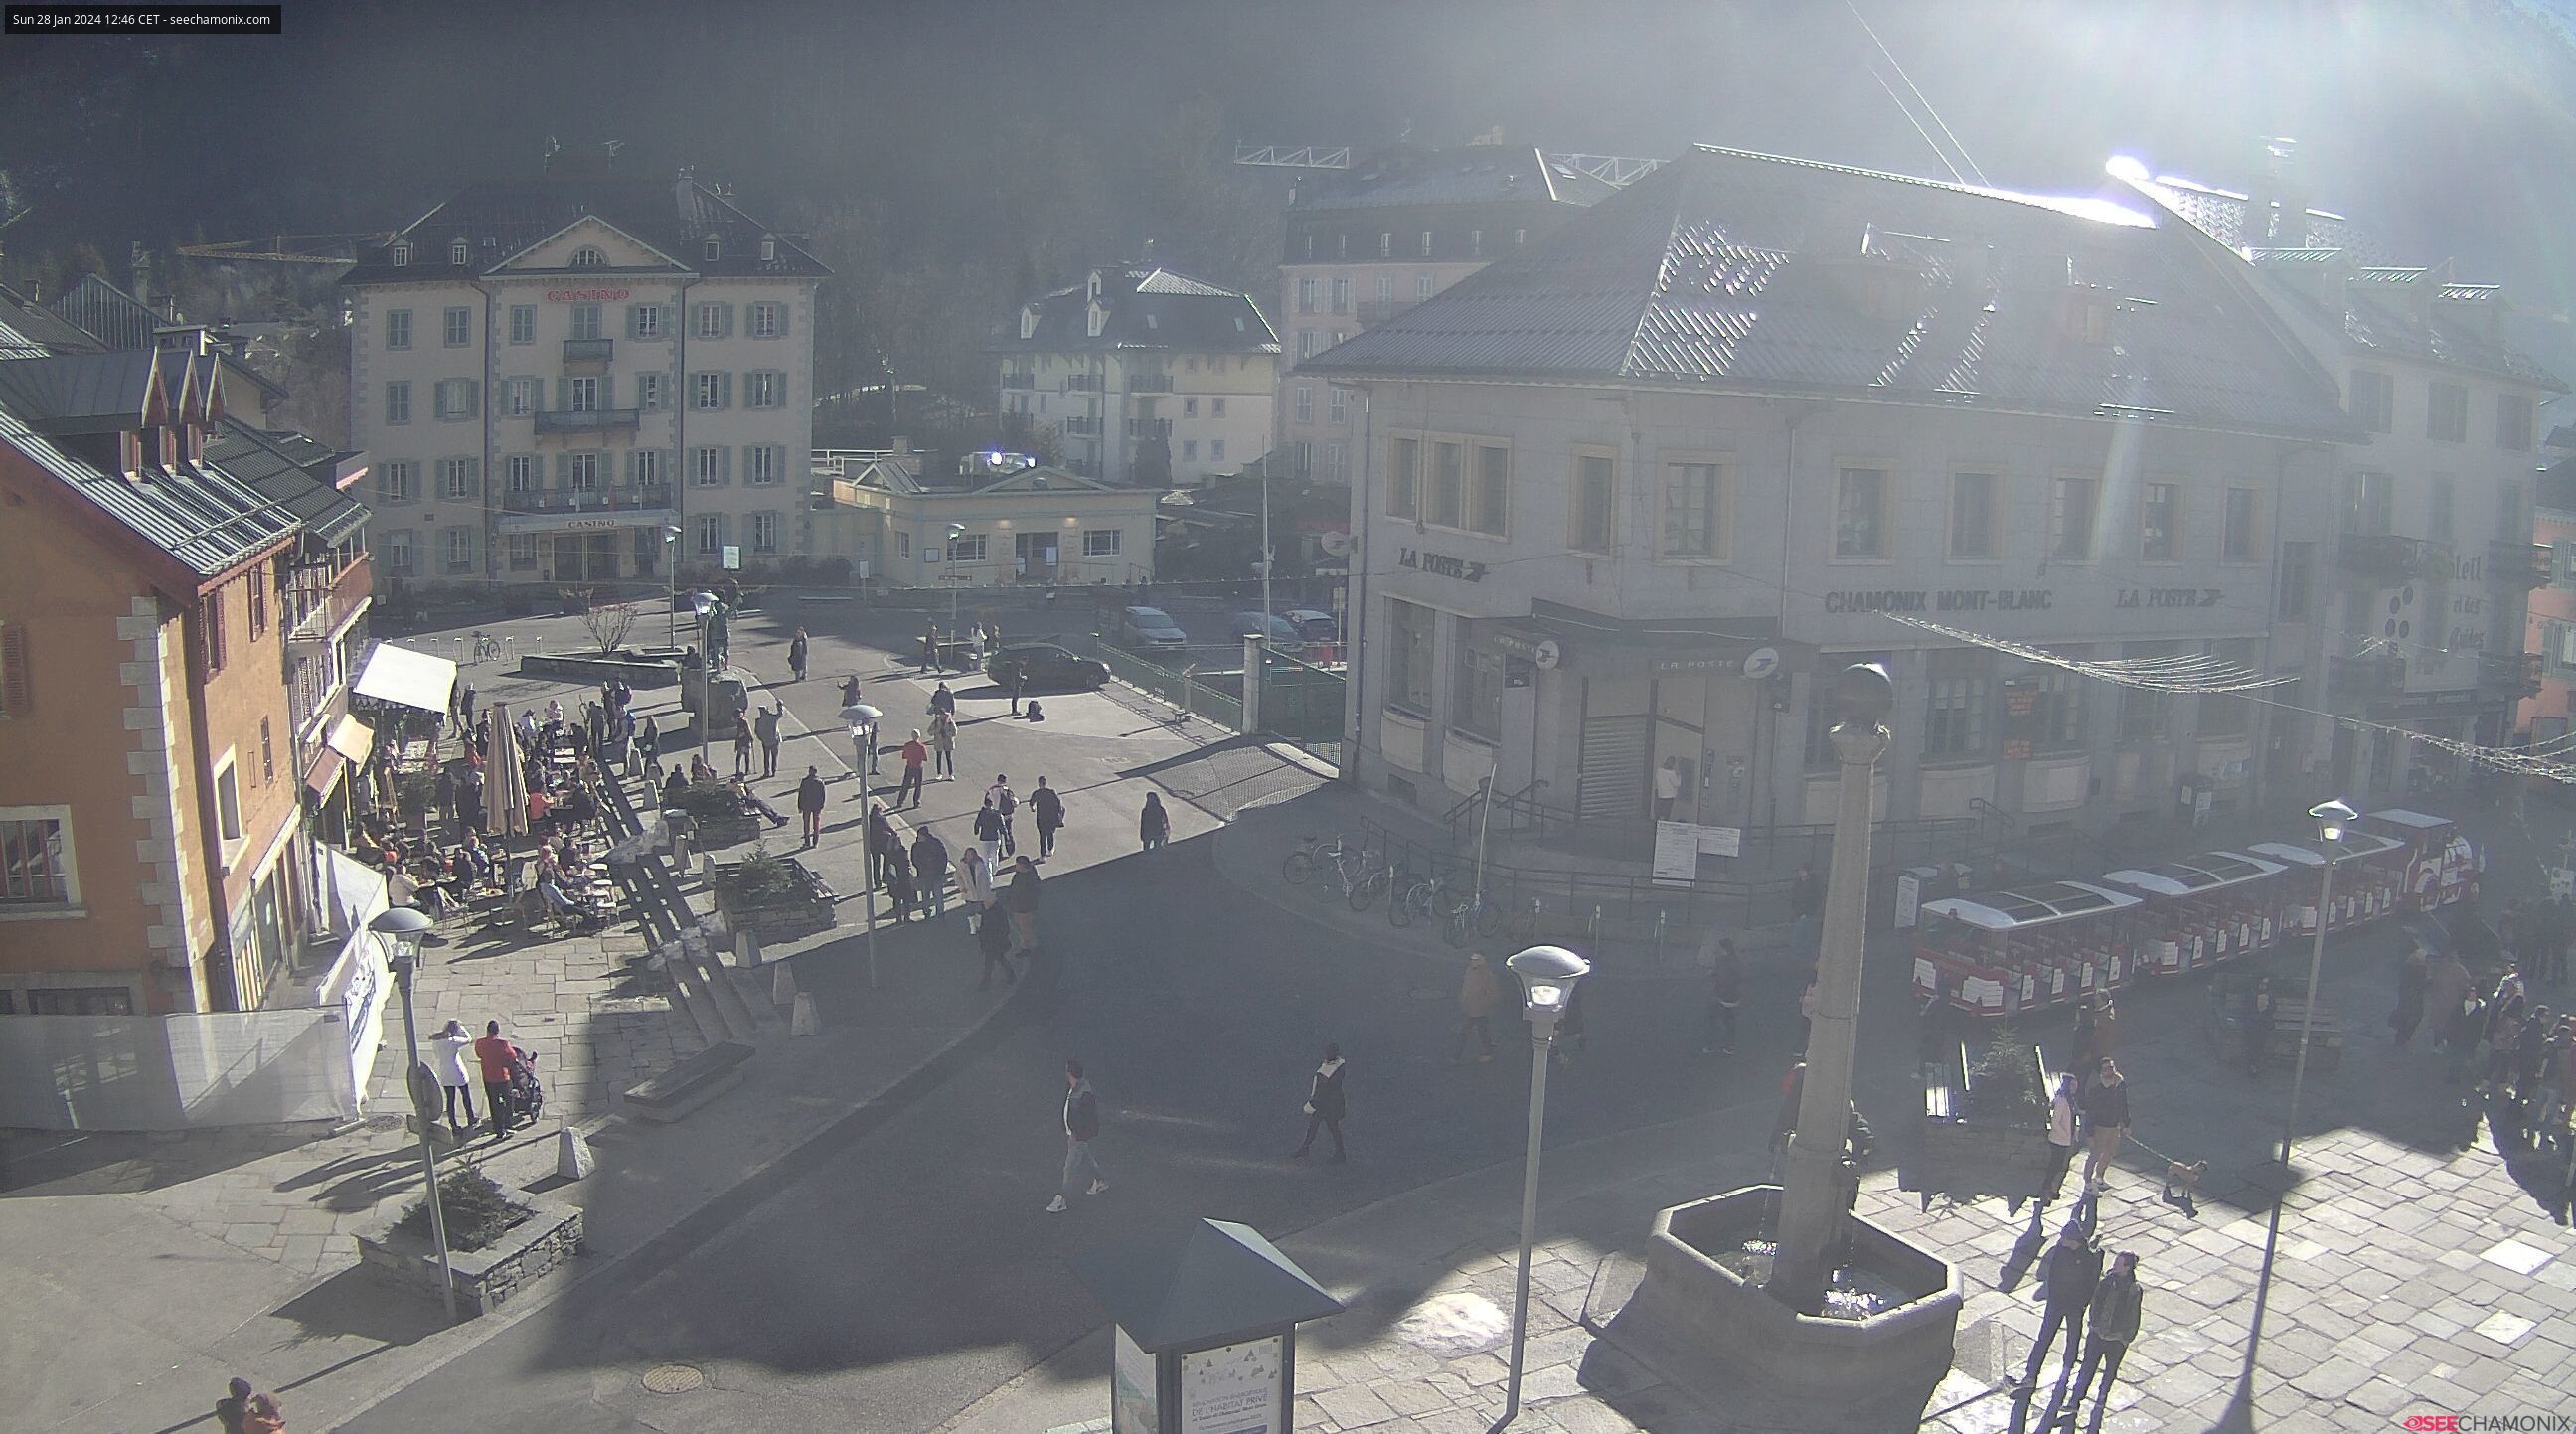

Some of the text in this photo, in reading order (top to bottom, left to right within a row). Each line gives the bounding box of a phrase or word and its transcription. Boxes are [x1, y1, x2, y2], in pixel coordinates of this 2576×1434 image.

[547, 289, 630, 301] CASINO
[567, 518, 615, 529] CASINO
[1398, 547, 1464, 579] LA POSTE
[1824, 589, 2053, 614] CHAMONIX MONT-BLANC
[2115, 587, 2197, 607] LA POSTE
[1660, 659, 1734, 670] LA POSTE
